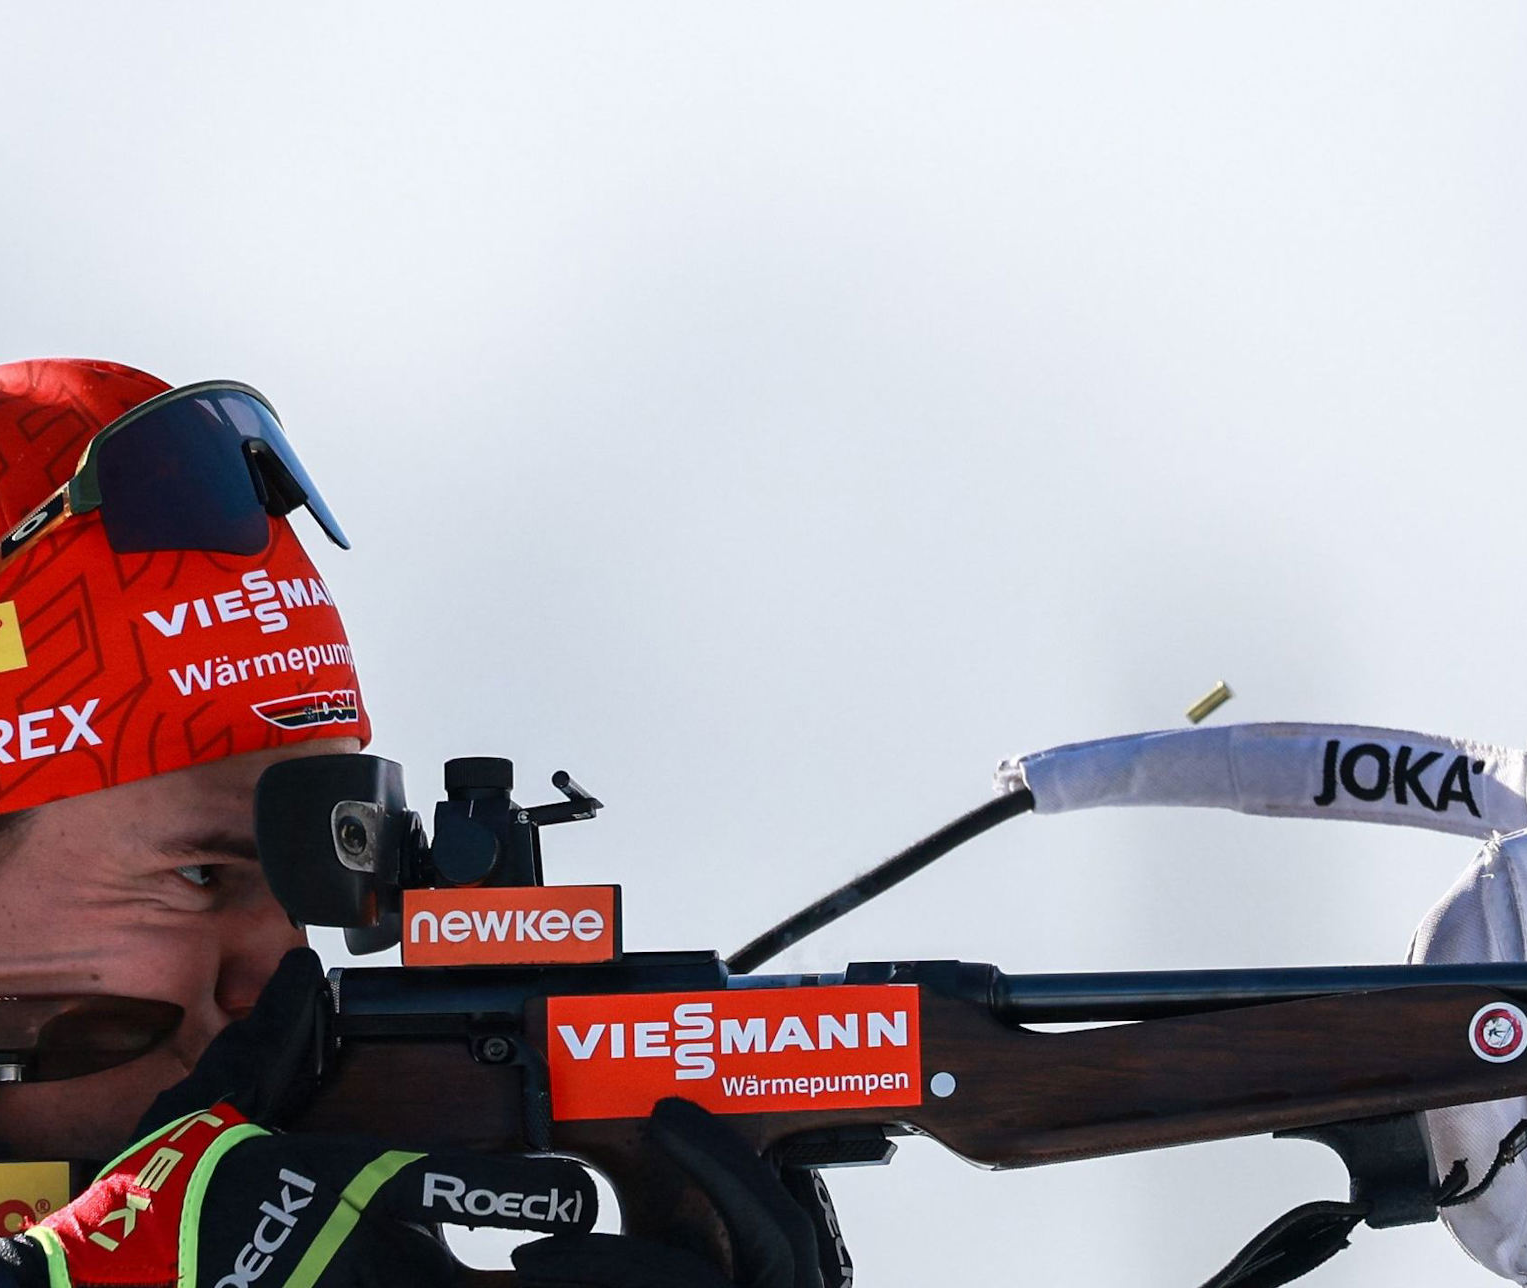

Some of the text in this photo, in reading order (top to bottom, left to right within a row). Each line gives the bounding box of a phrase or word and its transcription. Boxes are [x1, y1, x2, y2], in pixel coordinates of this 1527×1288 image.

[410, 908, 604, 943] newkee
[557, 1002, 908, 1081] VIESSMANN
[722, 1070, 909, 1098] Wärmepumpen
